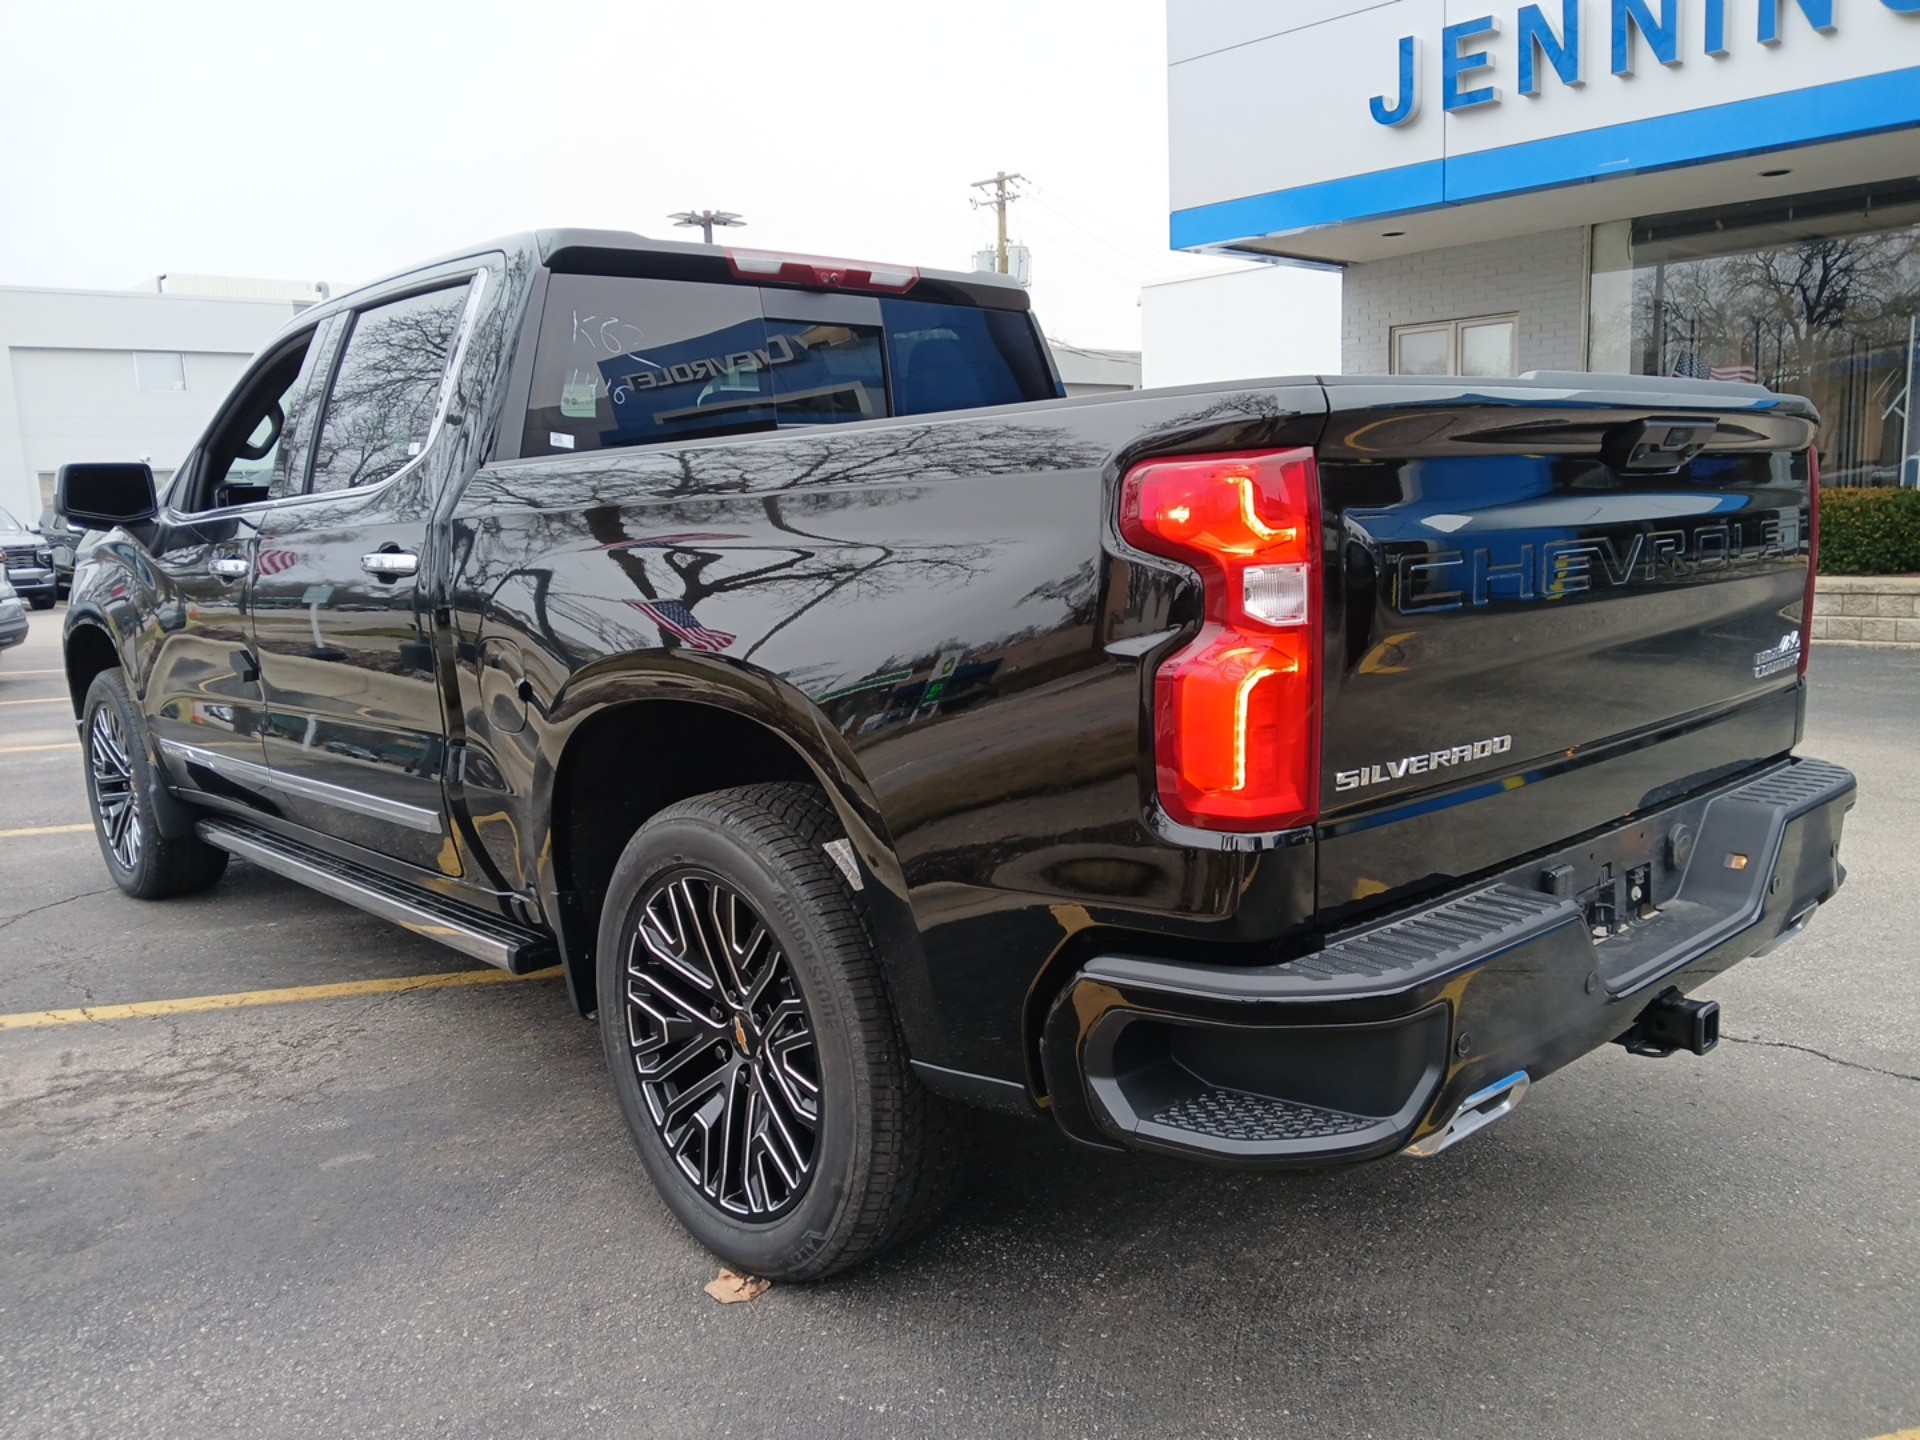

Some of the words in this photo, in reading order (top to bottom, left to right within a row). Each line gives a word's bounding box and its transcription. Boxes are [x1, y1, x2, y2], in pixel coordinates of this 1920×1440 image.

[1369, 0, 1920, 128] JENNIN
[1398, 515, 1808, 615] CHEVROLET
[1335, 734, 1512, 792] SILVERADO
